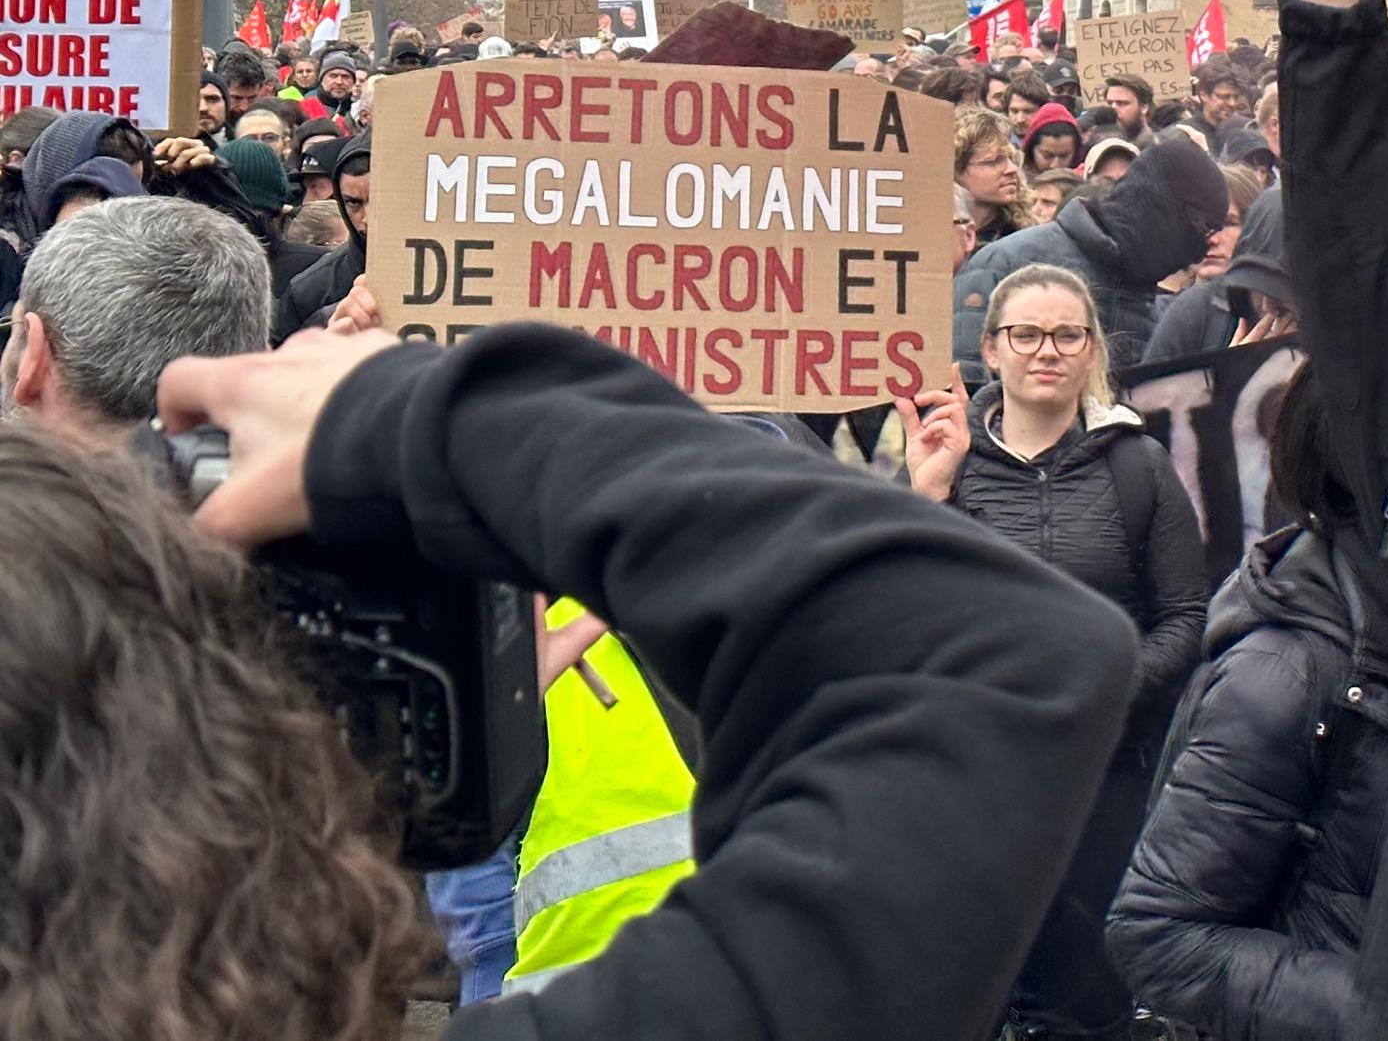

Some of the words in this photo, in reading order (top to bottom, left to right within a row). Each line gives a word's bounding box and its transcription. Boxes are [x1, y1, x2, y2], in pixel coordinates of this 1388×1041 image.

[529, 15, 573, 37] FION
[817, 4, 838, 20] 60
[843, 4, 872, 18] ANS
[1082, 16, 1181, 41] ETEIGNEZ
[0, 33, 110, 78] SURE
[1143, 58, 1175, 73] PAS
[424, 70, 795, 151] ARRETONS
[828, 87, 910, 154] LA
[423, 153, 904, 235] MEGALOMANIE
[402, 238, 495, 308] DE
[528, 240, 804, 313] MACRON
[837, 248, 920, 315] ET
[571, 325, 925, 399] NISTRES
